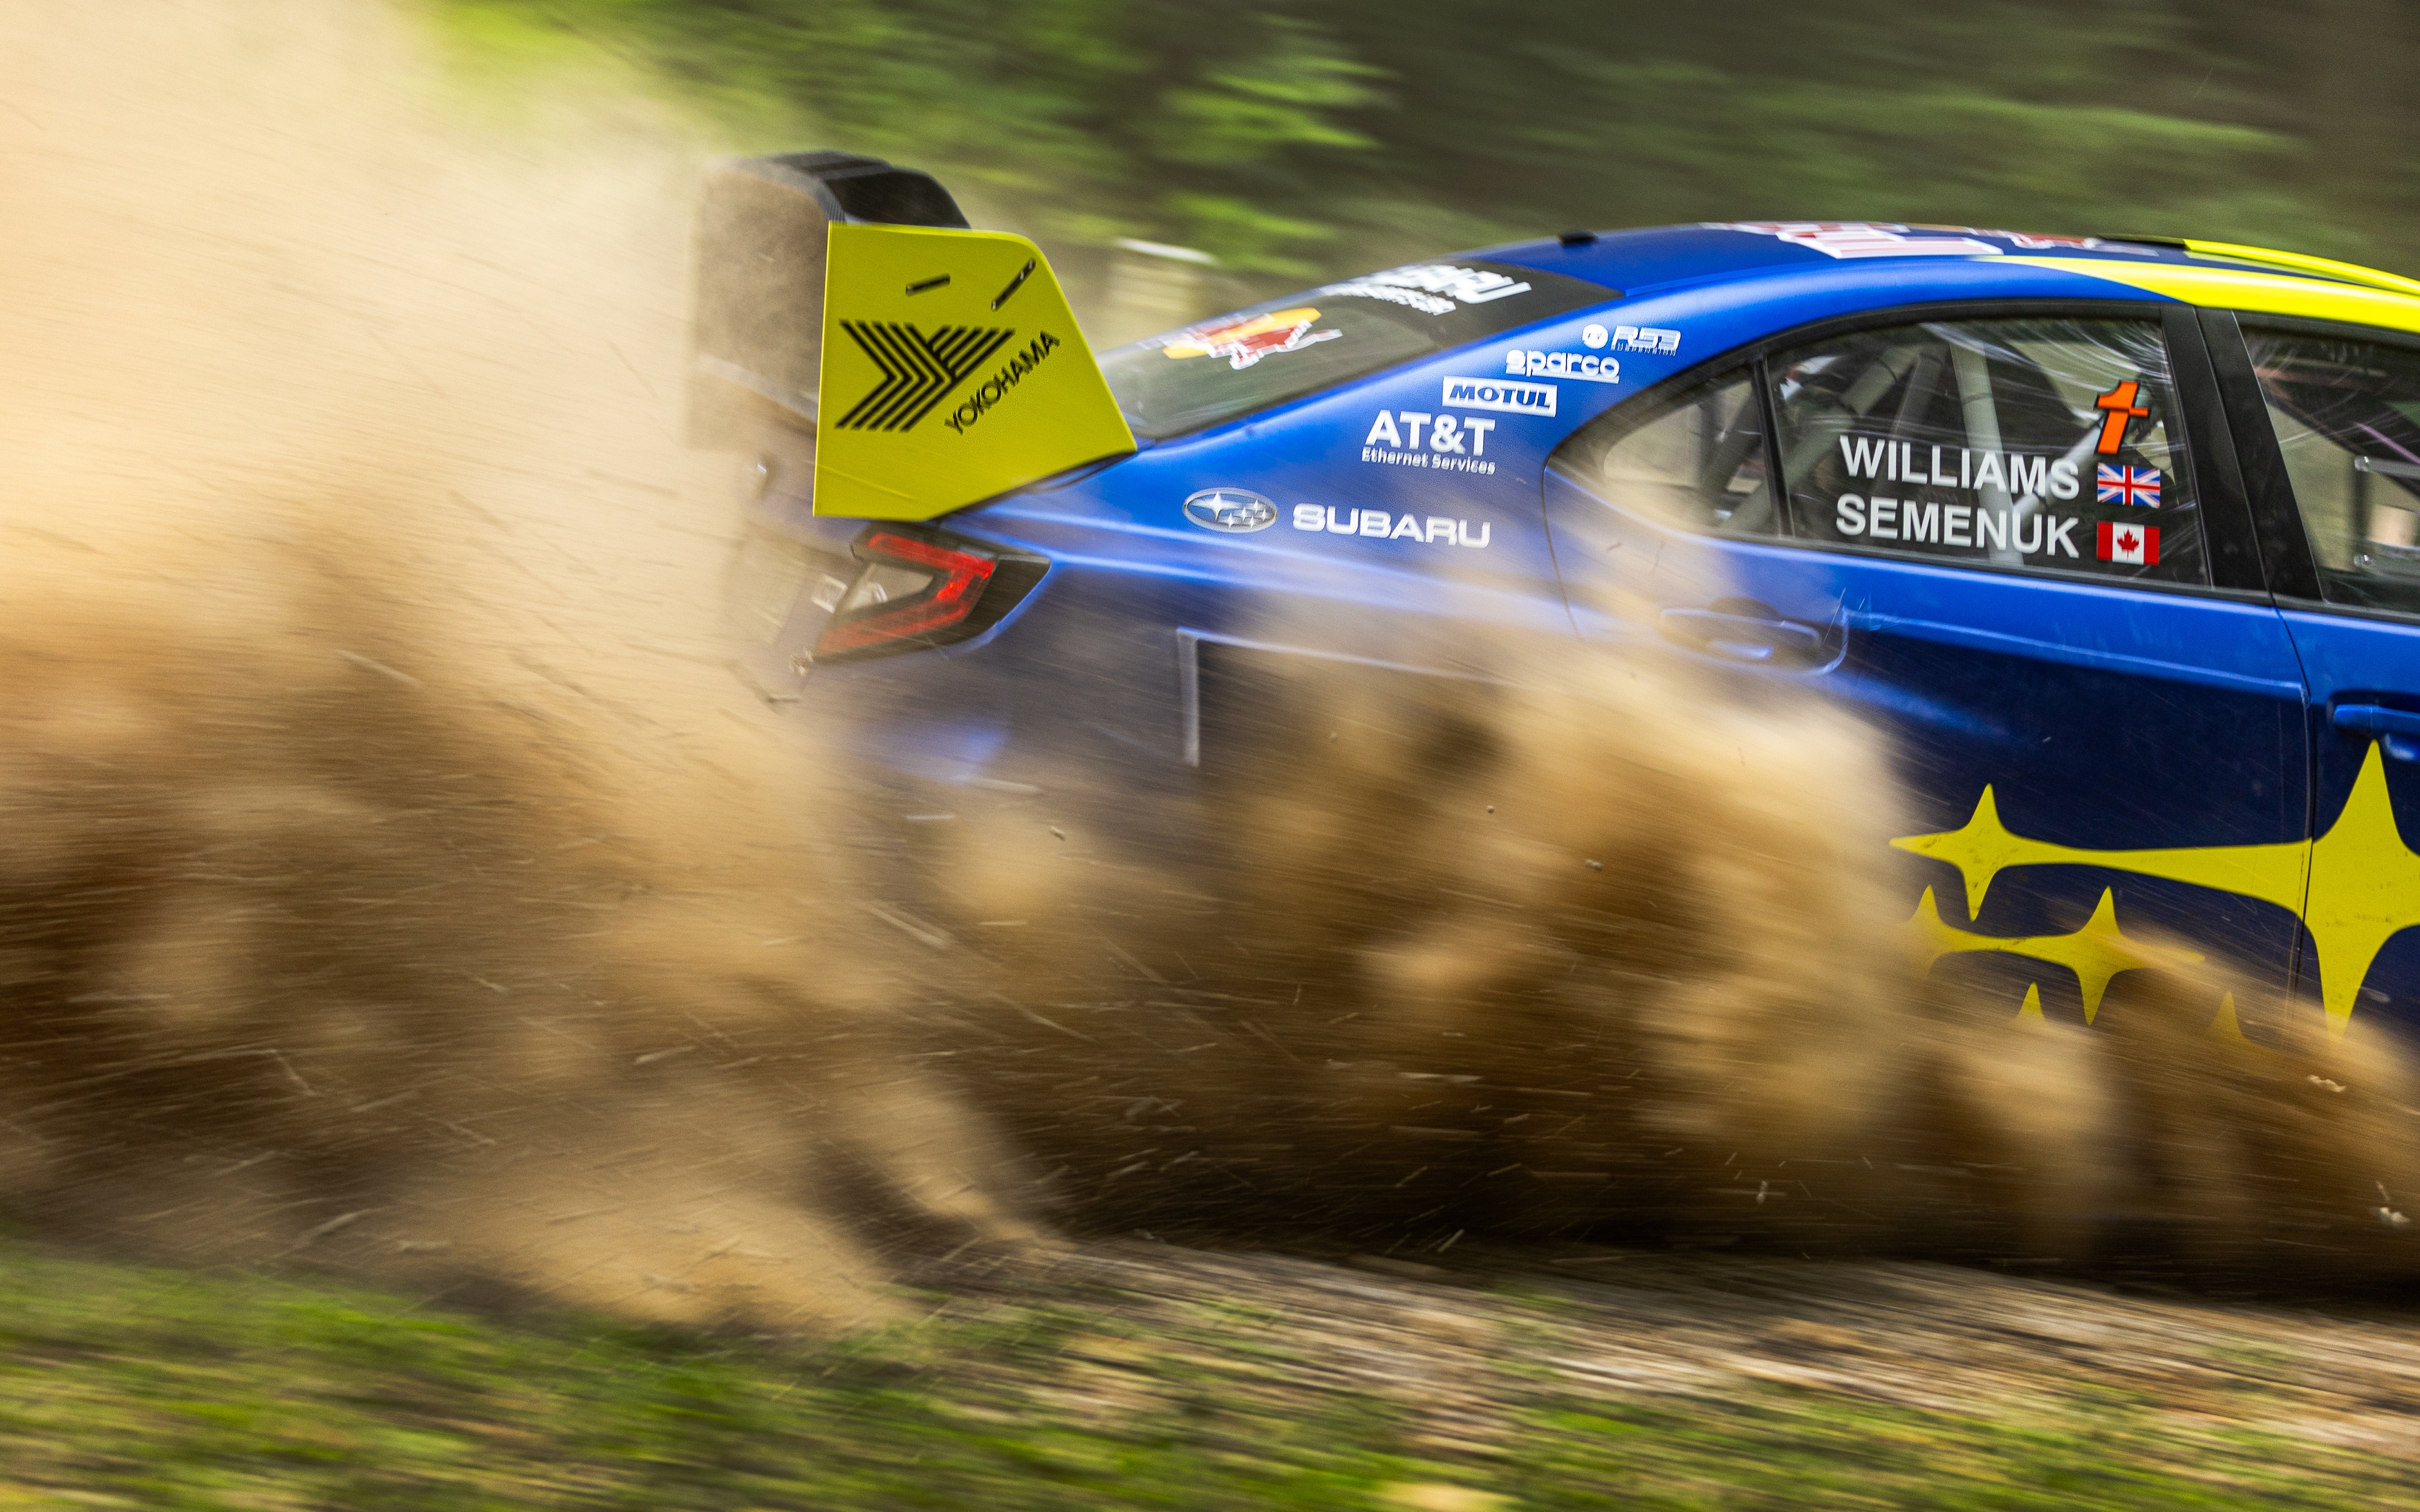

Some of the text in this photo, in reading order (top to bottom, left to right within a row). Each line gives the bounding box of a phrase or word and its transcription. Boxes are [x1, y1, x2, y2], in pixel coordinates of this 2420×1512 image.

[944, 330, 1060, 435] YOKOHAMA
[1506, 349, 1620, 380] sparco
[1449, 383, 1551, 409] MOTUL
[1365, 409, 1496, 456] AT&T
[1361, 446, 1496, 476] Ethernet Services
[1839, 434, 2080, 501] WILLIAMS
[1293, 503, 1491, 550] SUBARU
[1836, 493, 2079, 559] SEMENUK
